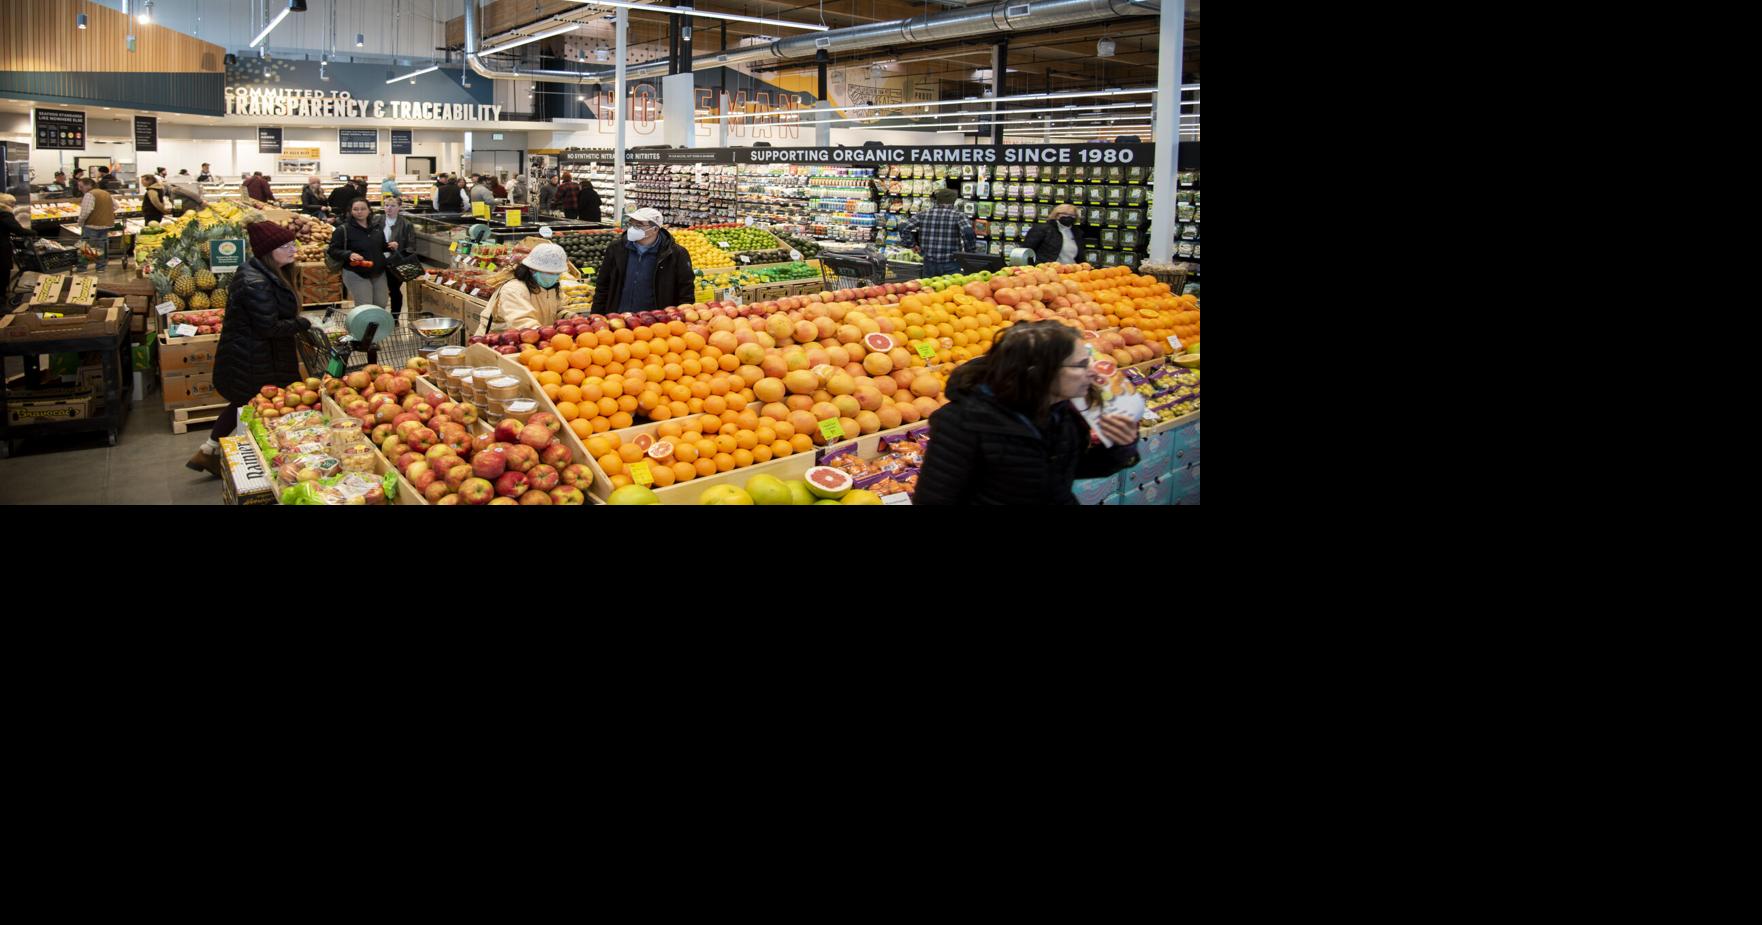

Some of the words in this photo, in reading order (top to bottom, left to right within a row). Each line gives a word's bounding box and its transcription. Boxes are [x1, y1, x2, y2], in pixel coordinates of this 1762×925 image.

[224, 86, 325, 98] COMMITTED
[330, 90, 351, 100] TO
[225, 96, 369, 118] TRANSPARENCY
[373, 99, 385, 118] &
[390, 100, 502, 121] TRACEABILITY
[750, 150, 829, 161] SUPPORTING
[832, 149, 905, 161] ORGANIC
[911, 149, 996, 162] FARMERS
[1004, 148, 1070, 163] SINCE
[1078, 148, 1134, 163] 1980
